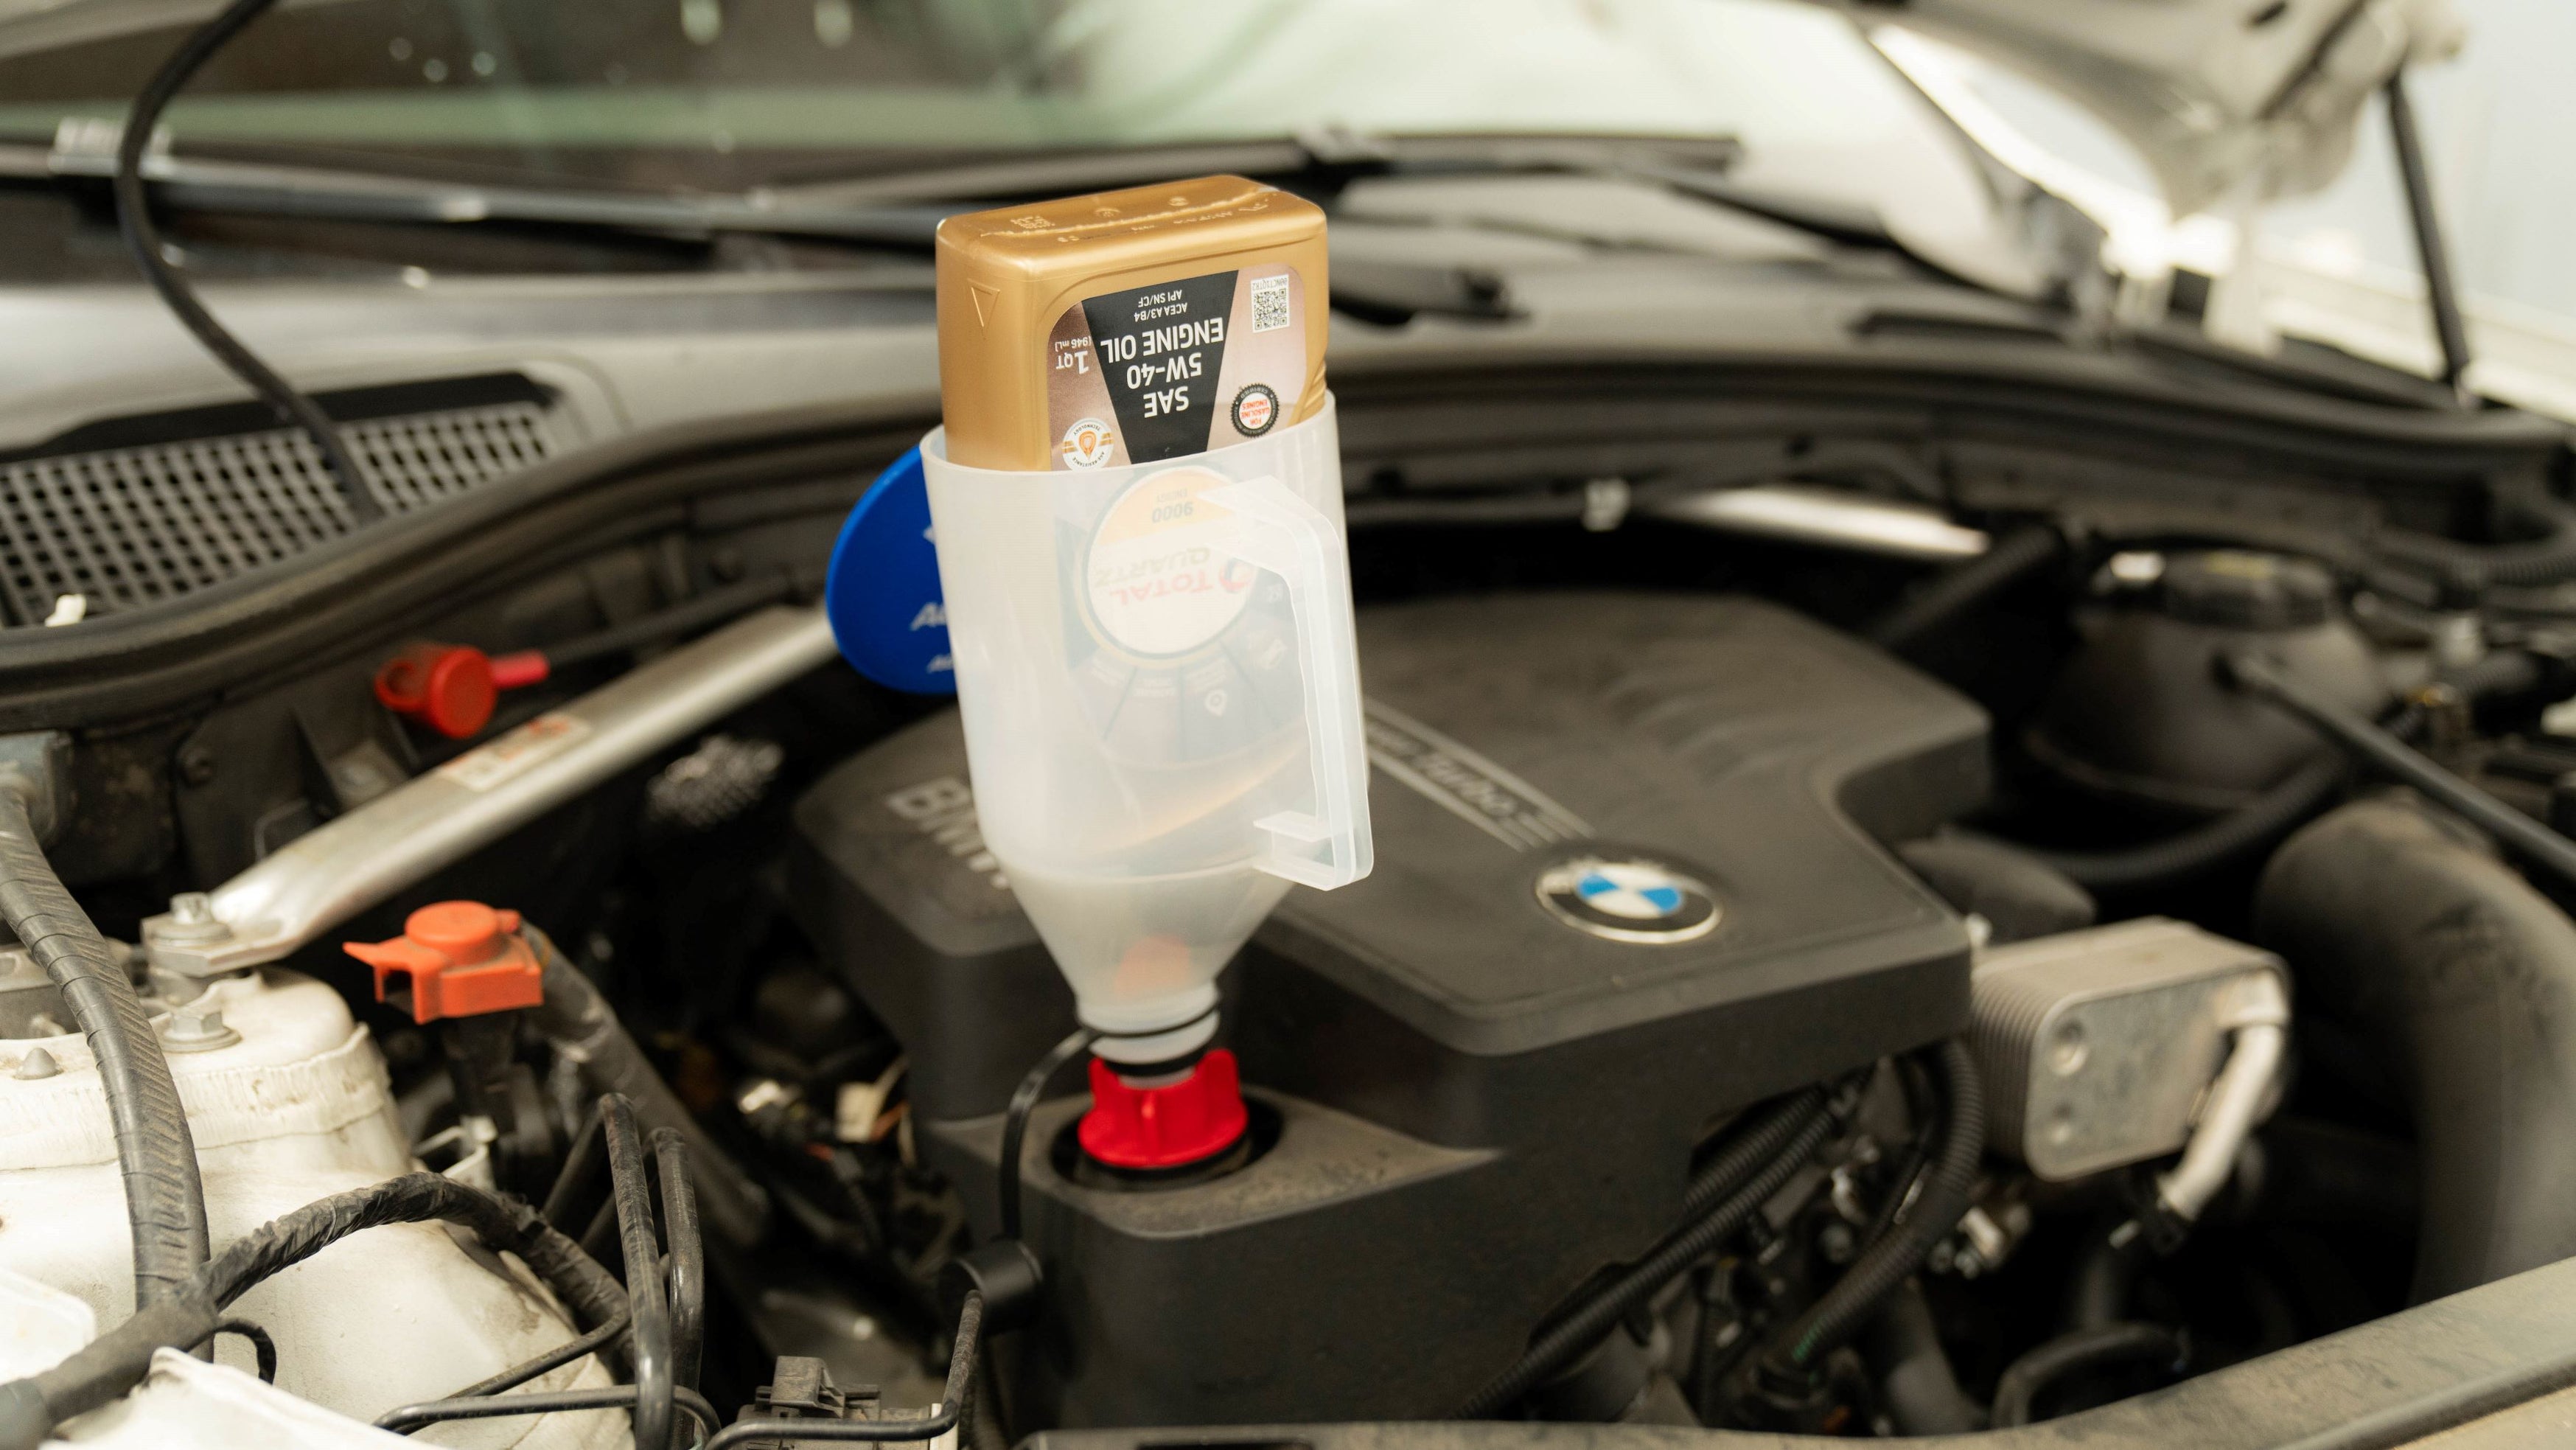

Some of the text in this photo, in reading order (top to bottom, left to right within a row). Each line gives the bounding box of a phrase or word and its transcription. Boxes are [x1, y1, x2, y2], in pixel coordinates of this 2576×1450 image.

[1137, 289, 1183, 308] API SN/CF
[1134, 301, 1188, 322] ACEA A3/B4
[1100, 317, 1224, 363] ENGINE OIL
[1126, 352, 1202, 390] 5W-40
[1143, 386, 1190, 419] SAE
[1240, 406, 1270, 419] GASOLINE
[1241, 399, 1268, 410] ENGINES
[1073, 424, 1101, 436] TECHNOLOGY
[1249, 418, 1262, 426] FOR
[1072, 450, 1105, 468] AGE-RESISTANCE
[1151, 501, 1194, 523] 9000
[1095, 547, 1211, 588] QUARTZ
[1109, 569, 1214, 606] TOTAL
